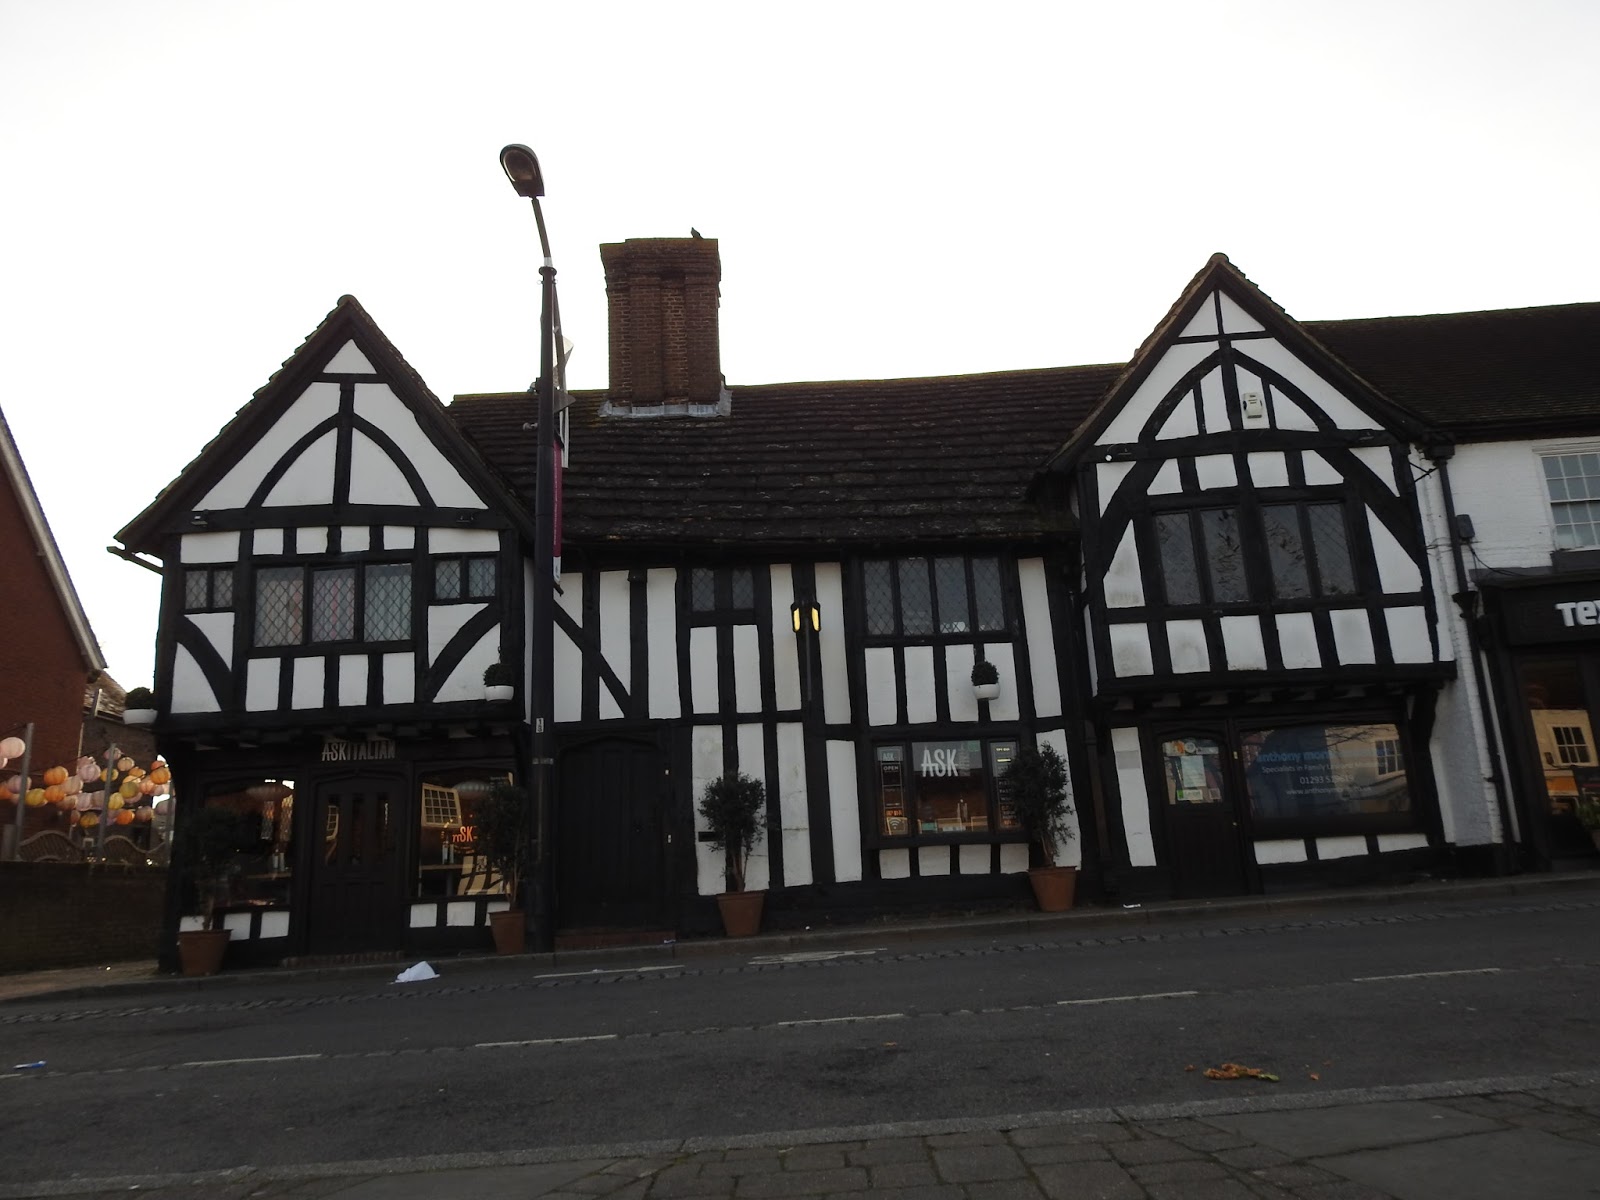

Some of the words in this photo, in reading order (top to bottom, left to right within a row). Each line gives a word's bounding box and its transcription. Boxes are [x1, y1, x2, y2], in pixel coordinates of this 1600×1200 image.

[321, 742, 346, 761] ASK
[347, 740, 395, 760] ITALIAN
[921, 747, 959, 777] ASK
[1299, 776, 1324, 785] 01293
